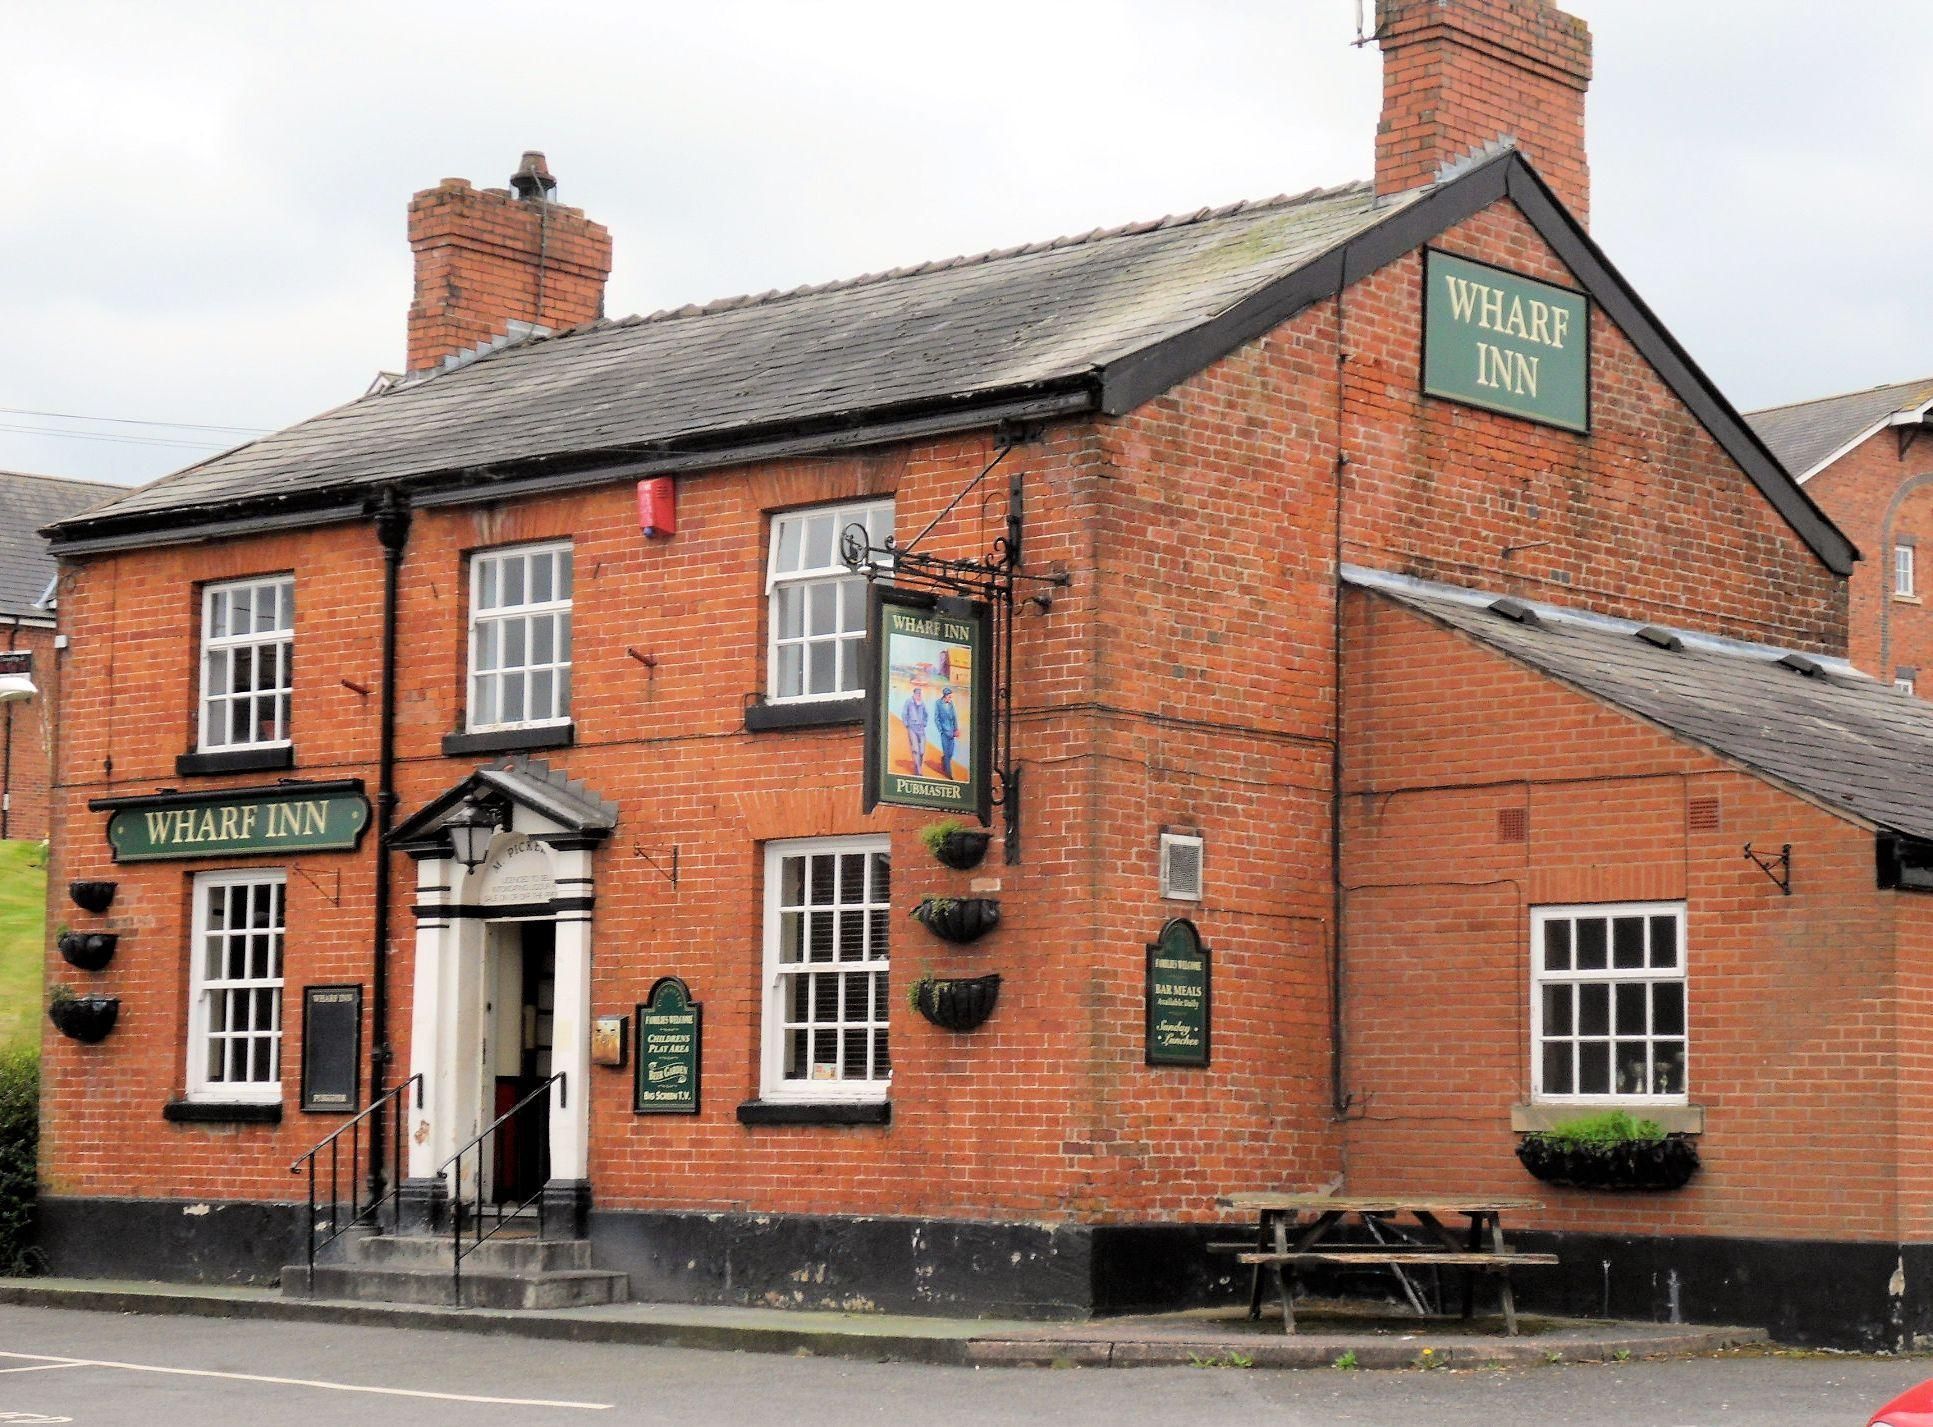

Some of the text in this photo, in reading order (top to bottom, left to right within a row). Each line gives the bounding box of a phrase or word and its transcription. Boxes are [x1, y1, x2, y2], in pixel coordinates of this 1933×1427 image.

[1445, 275, 1570, 349] WHARF
[1476, 342, 1541, 398] INN
[892, 614, 970, 640] WHARF INN
[896, 778, 962, 799] PUBMASTER
[144, 800, 331, 846] WHARF INN
[1155, 983, 1202, 997] BAR MEALS
[1156, 1019, 1191, 1036] Sunday
[647, 1034, 690, 1043] CHILDRENS
[648, 1044, 689, 1053] PLAY AREA
